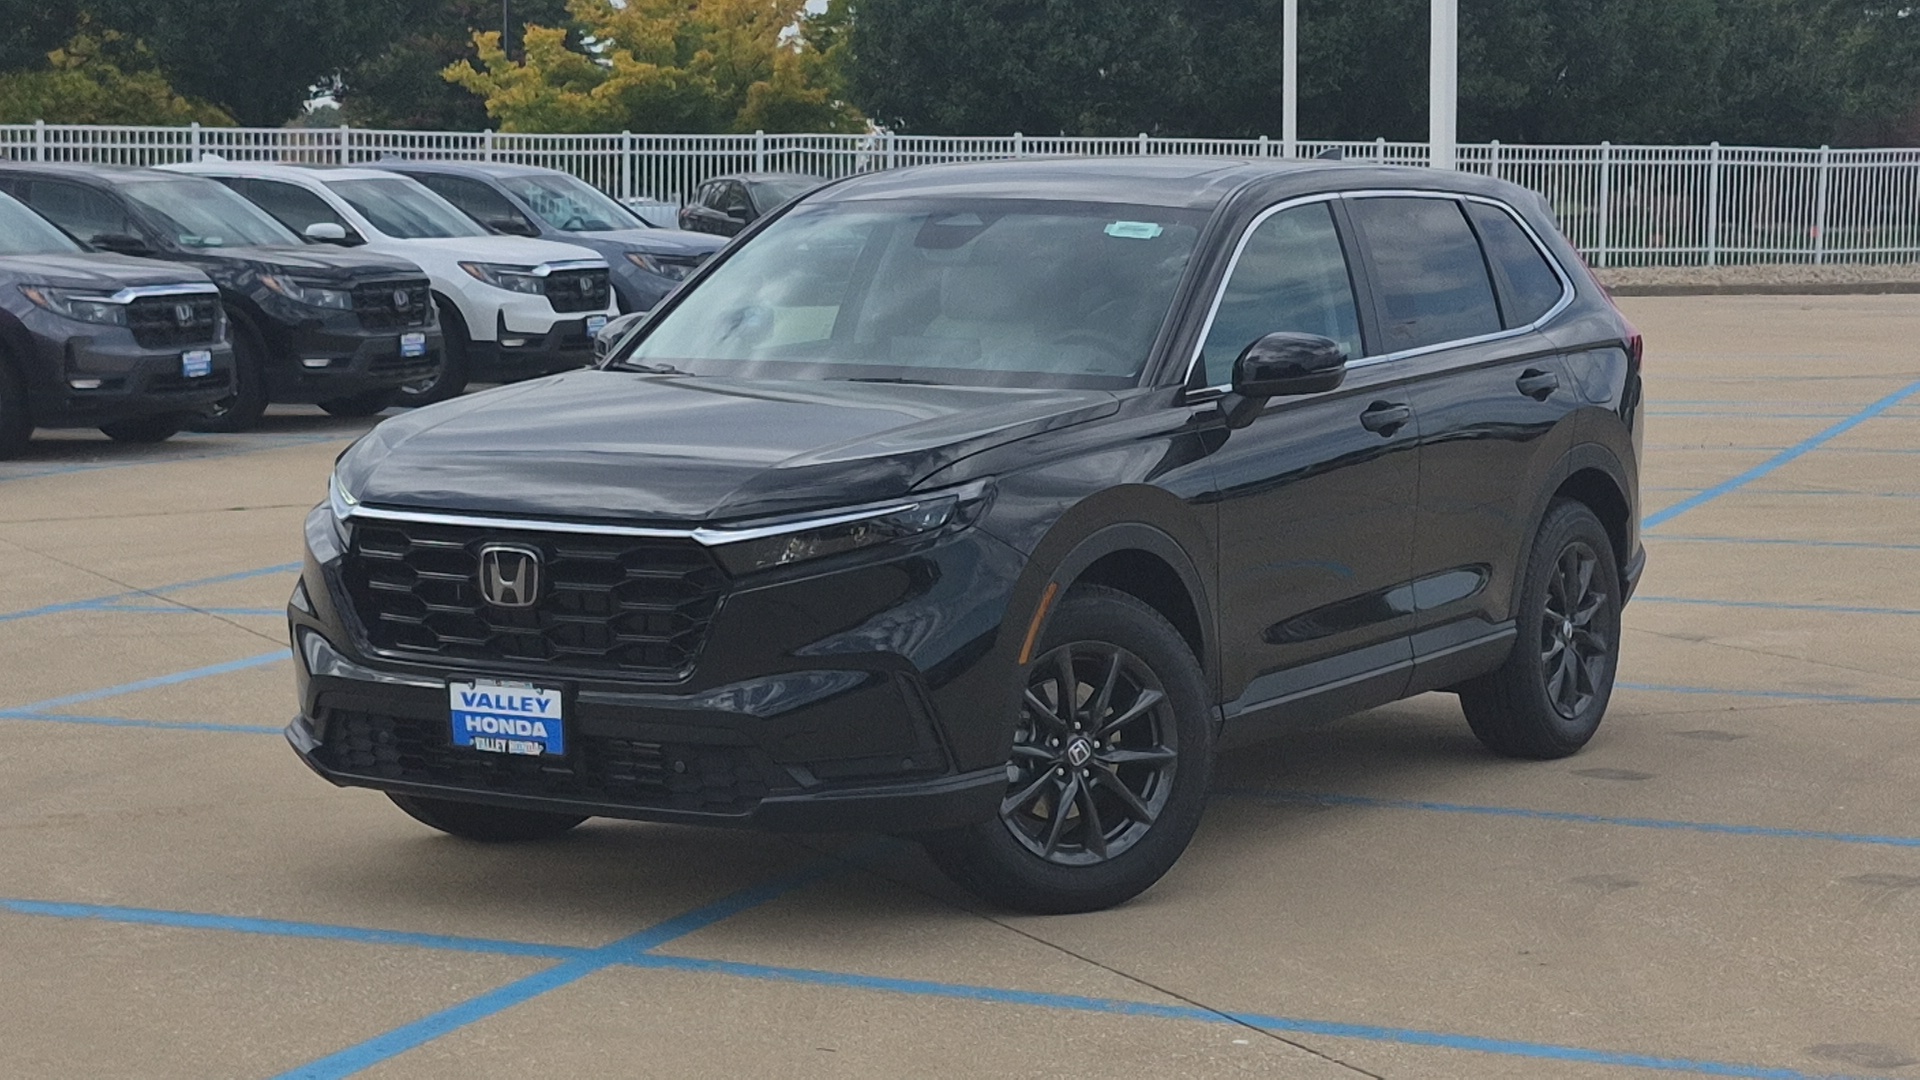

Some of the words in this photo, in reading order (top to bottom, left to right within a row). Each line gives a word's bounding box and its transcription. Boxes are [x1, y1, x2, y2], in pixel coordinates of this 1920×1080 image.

[460, 691, 551, 713] VALLEY
[465, 715, 548, 737] HONDA
[475, 737, 506, 752] VALLEY
